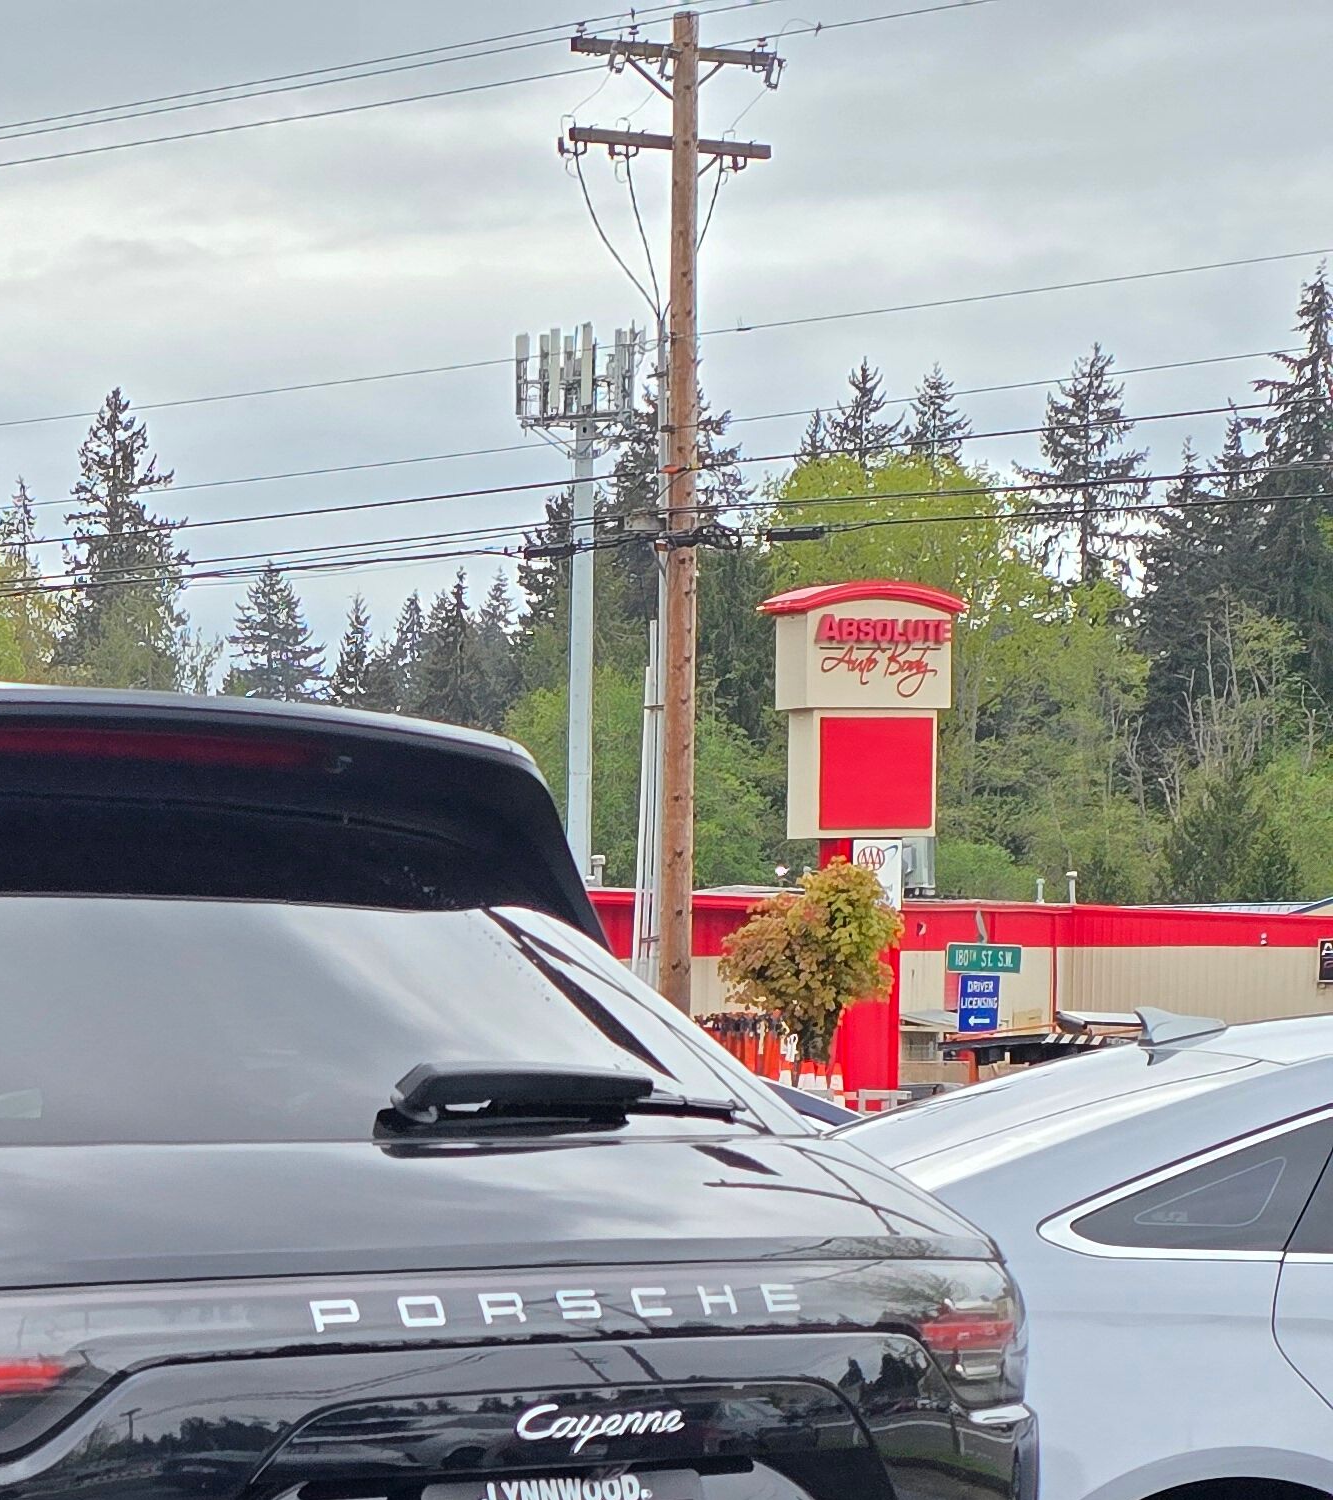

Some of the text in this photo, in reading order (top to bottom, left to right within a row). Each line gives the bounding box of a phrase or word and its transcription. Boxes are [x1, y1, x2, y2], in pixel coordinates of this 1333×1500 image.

[815, 614, 951, 643] ABSOLUTE
[821, 641, 937, 697] Auto Body
[960, 997, 998, 1009] LICENSING
[967, 980, 993, 993] DRIVER
[309, 1283, 801, 1333] PORSCHE
[516, 1403, 686, 1454] Cayenne
